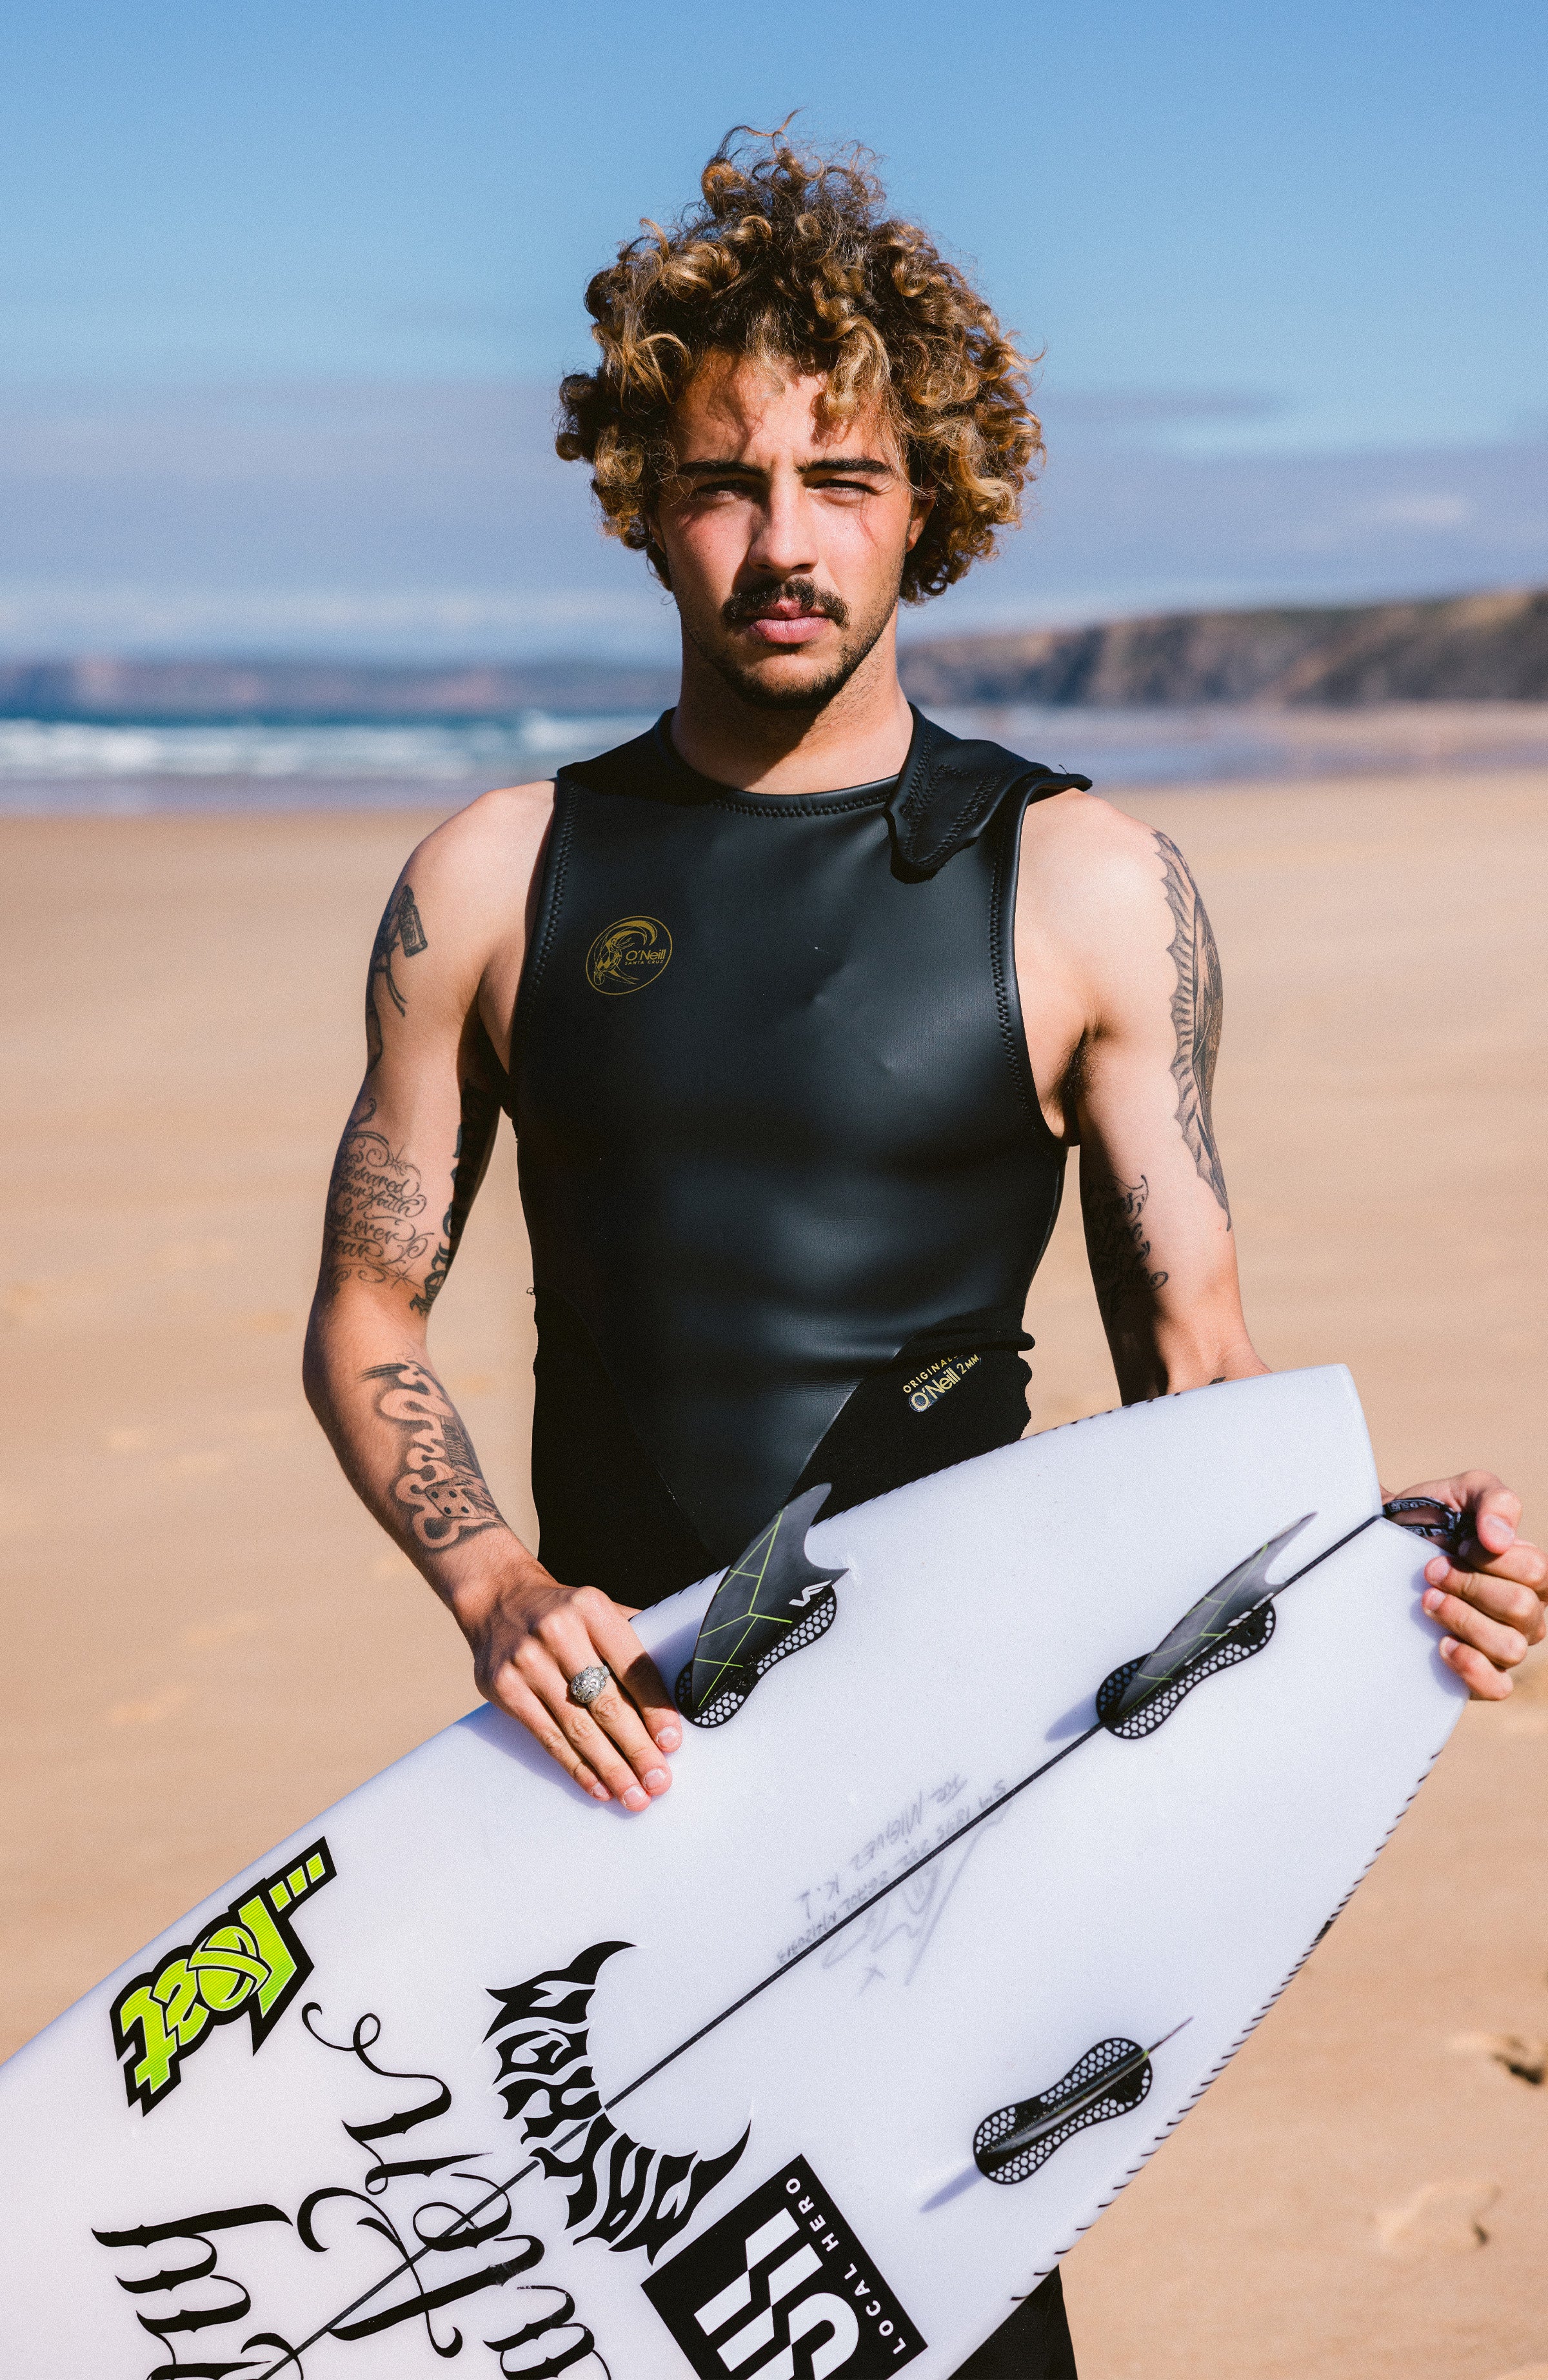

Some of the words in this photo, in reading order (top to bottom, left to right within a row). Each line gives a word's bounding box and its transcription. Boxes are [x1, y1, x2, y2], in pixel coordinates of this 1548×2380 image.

[626, 949, 666, 960] O'Neill
[357, 1191, 427, 1218] faith
[911, 1367, 961, 1410] O'Neill
[482, 1941, 751, 2266] MAYHEM
[786, 2178, 839, 2252] HERO
[844, 2263, 907, 2354] LOCAL
